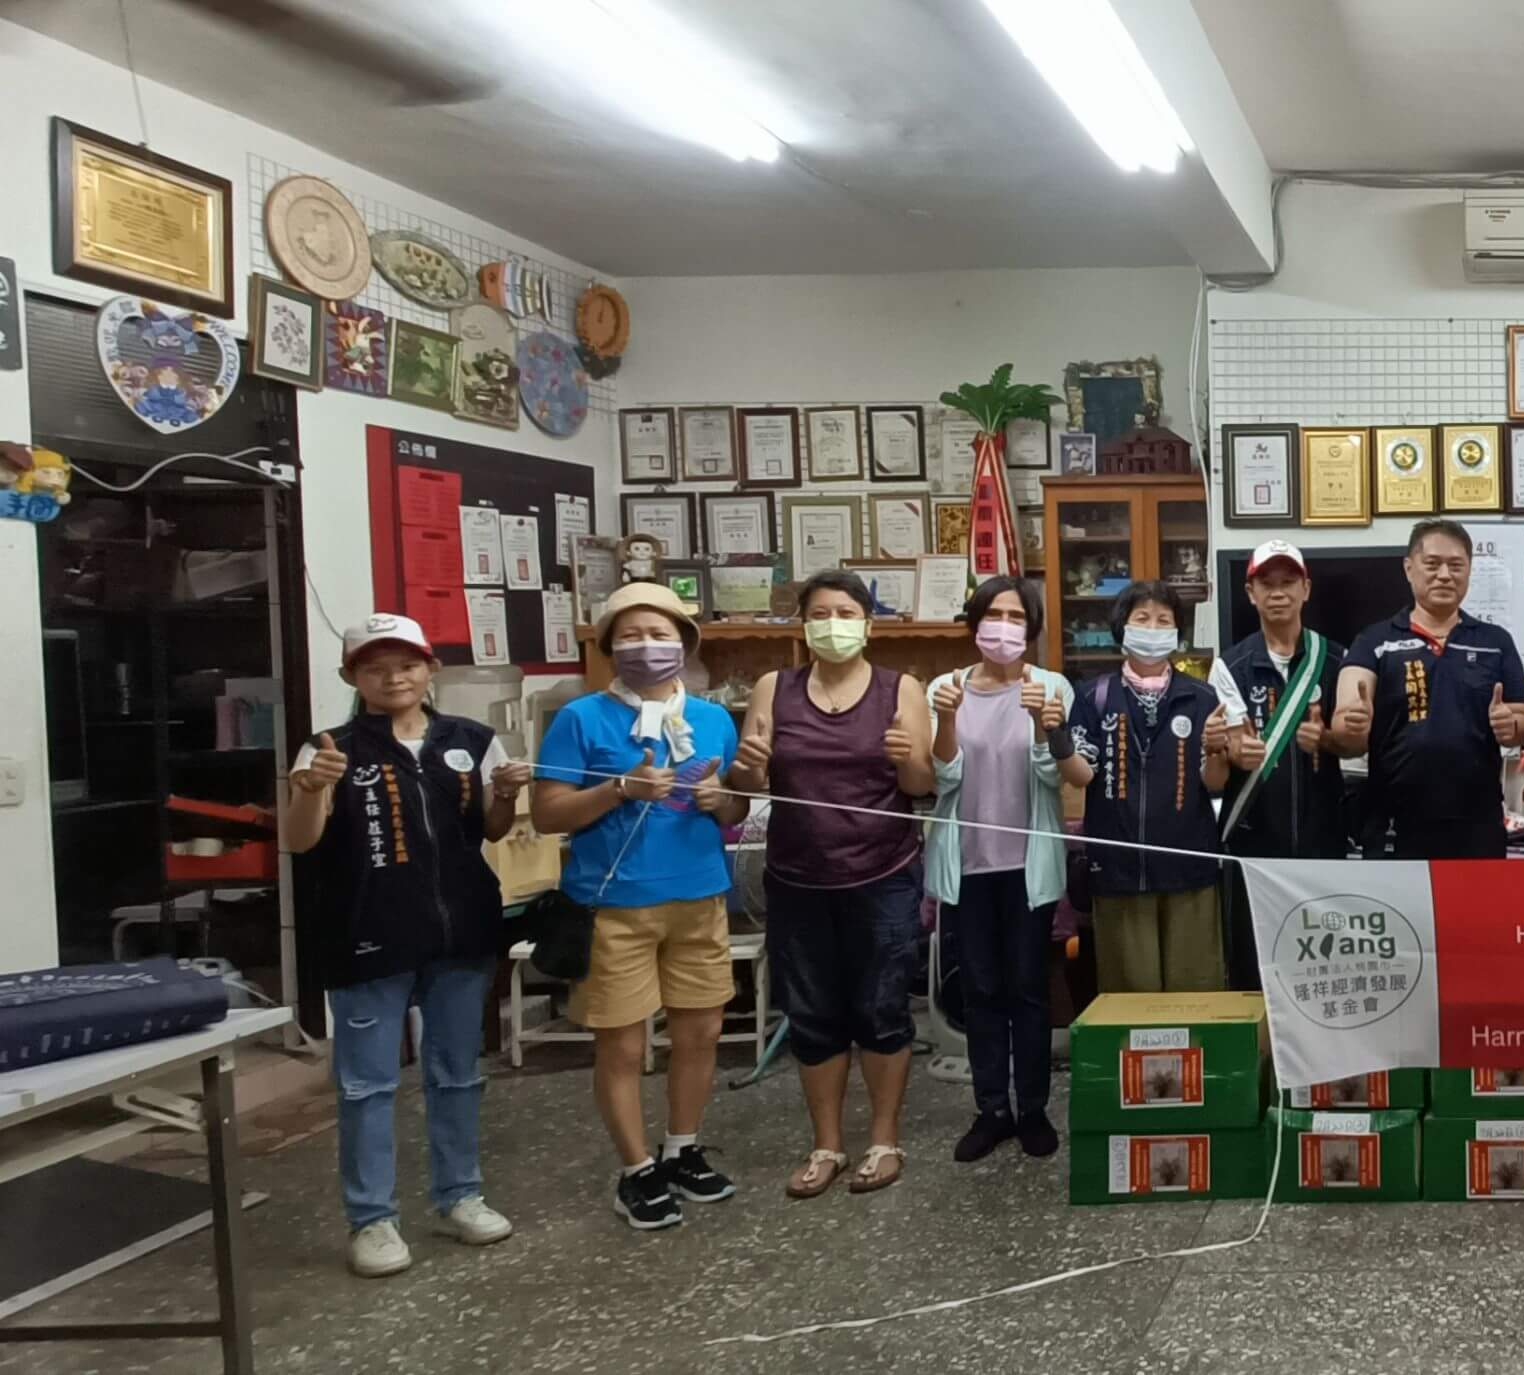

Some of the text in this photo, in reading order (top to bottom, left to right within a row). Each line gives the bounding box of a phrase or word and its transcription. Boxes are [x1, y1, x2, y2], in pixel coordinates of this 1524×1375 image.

[1294, 974, 1407, 1002] 隆祥經濟發展
[1323, 996, 1379, 1019] 基金會
